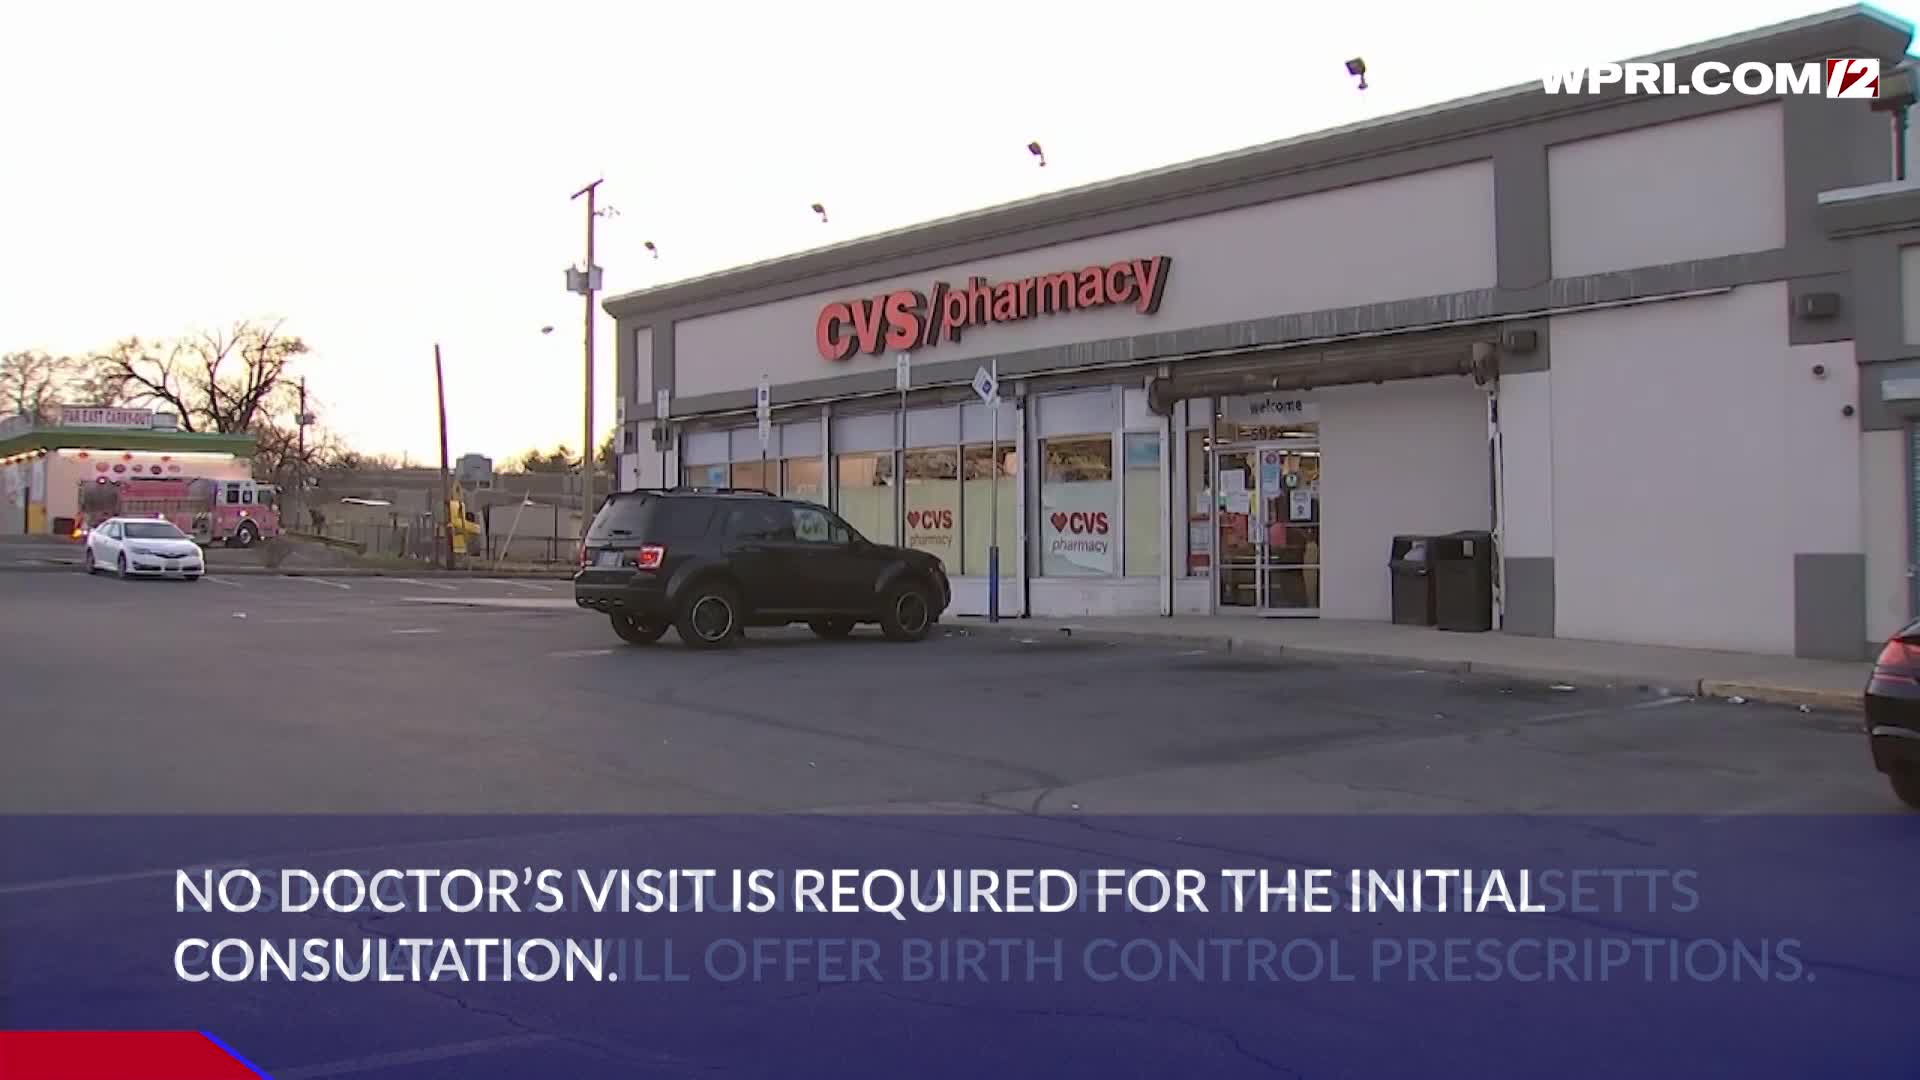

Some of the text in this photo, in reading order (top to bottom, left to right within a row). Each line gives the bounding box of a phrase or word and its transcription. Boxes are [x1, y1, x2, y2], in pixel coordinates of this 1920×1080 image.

[921, 510, 952, 529] CVS
[1069, 512, 1109, 535] CVS
[910, 533, 952, 548] pharmacy
[1052, 536, 1108, 553] pharmacy
